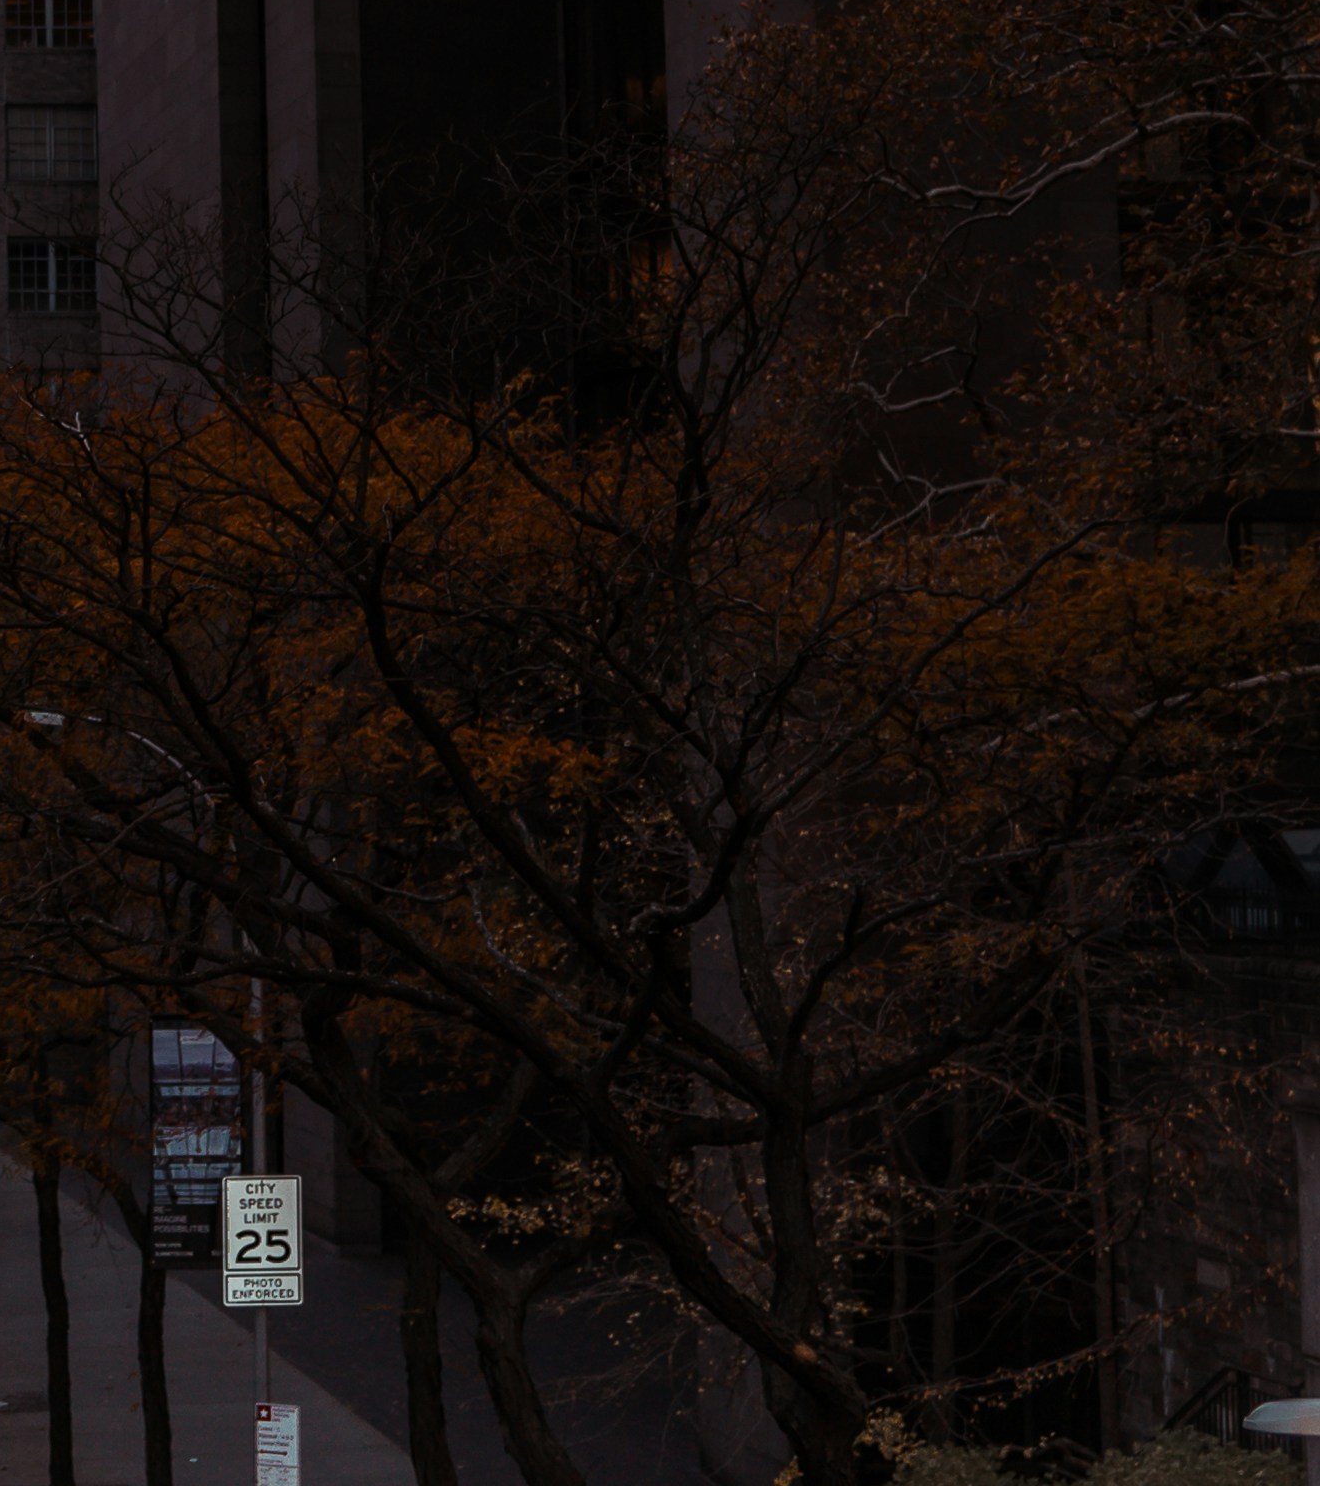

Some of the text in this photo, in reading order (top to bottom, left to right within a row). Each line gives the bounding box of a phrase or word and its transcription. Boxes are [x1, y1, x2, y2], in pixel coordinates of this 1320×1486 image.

[246, 1183, 276, 1194] CITY
[239, 1198, 284, 1210] SPEED
[244, 1212, 280, 1224] LIMIT
[235, 1229, 292, 1264] 25
[244, 1278, 283, 1288] PHOTO
[232, 1289, 295, 1300] ENFORCED
